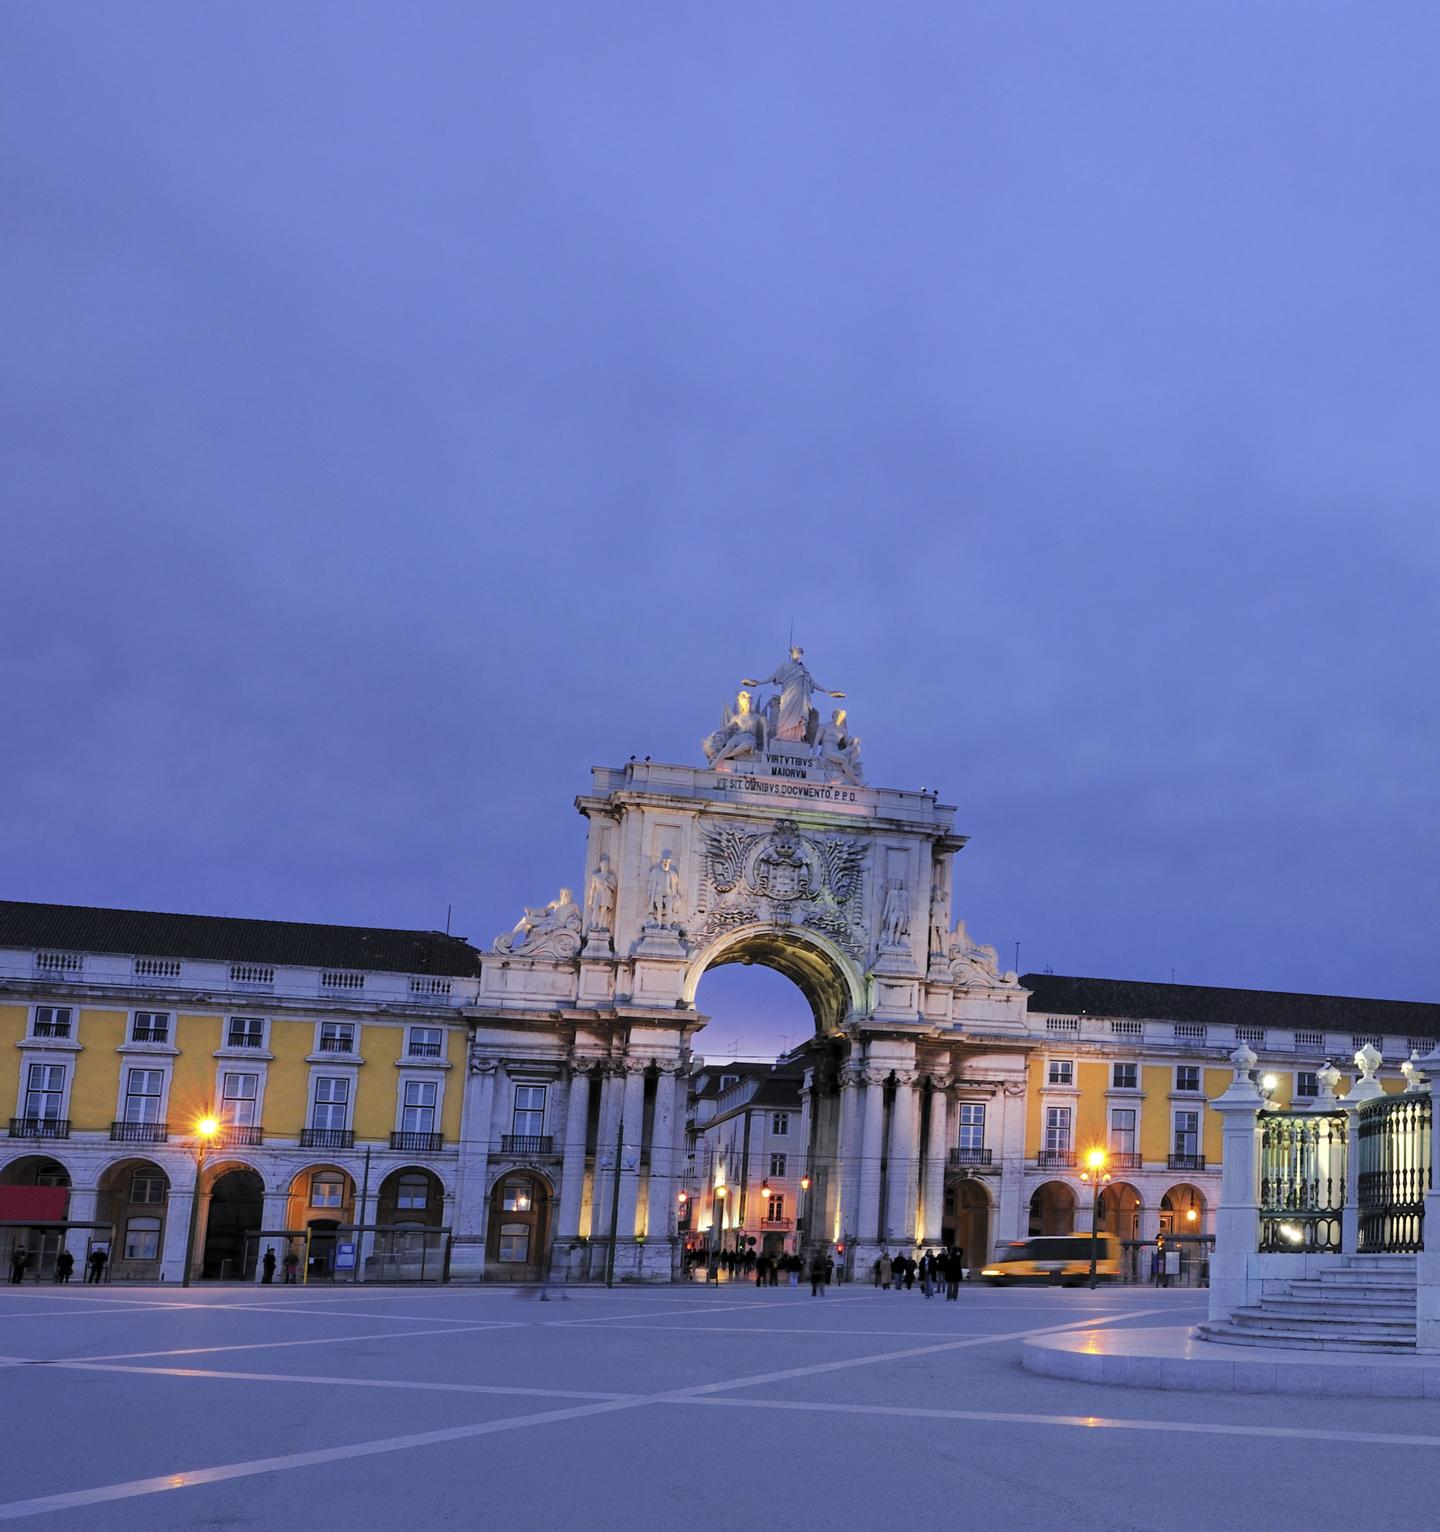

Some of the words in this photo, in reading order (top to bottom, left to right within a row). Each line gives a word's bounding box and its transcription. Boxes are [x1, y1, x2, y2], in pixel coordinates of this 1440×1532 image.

[766, 754, 813, 767] VIRTVTIBVS
[771, 767, 807, 779] MAIORVM
[744, 780, 779, 794] OMNIBVS
